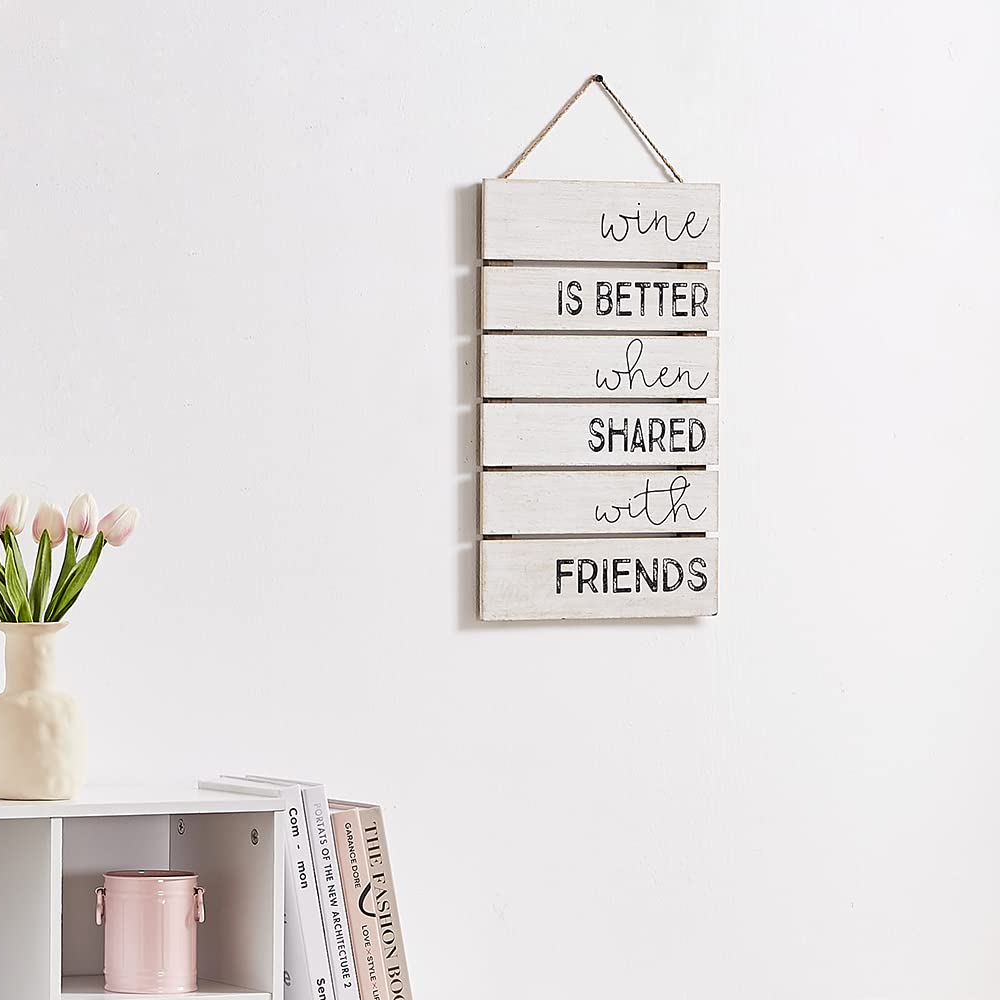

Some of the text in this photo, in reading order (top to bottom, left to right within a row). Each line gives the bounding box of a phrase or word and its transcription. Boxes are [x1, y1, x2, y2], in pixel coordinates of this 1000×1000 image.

[600, 203, 710, 242] wine
[557, 280, 710, 318] IS BETTER
[595, 338, 710, 391] when
[587, 417, 708, 453] SHARED
[594, 475, 708, 526] with
[554, 557, 709, 595] FRIENDS
[288, 807, 300, 838] Com
[297, 860, 309, 889] mon
[344, 821, 362, 889] GARANCE DORE
[364, 821, 383, 868] THE
[313, 803, 352, 989] PORTATS OF THE NEW ARCHITECTURE 2
[372, 872, 398, 960] FASHION
[361, 924, 372, 949] LOVE
[366, 955, 377, 982] STYLE
